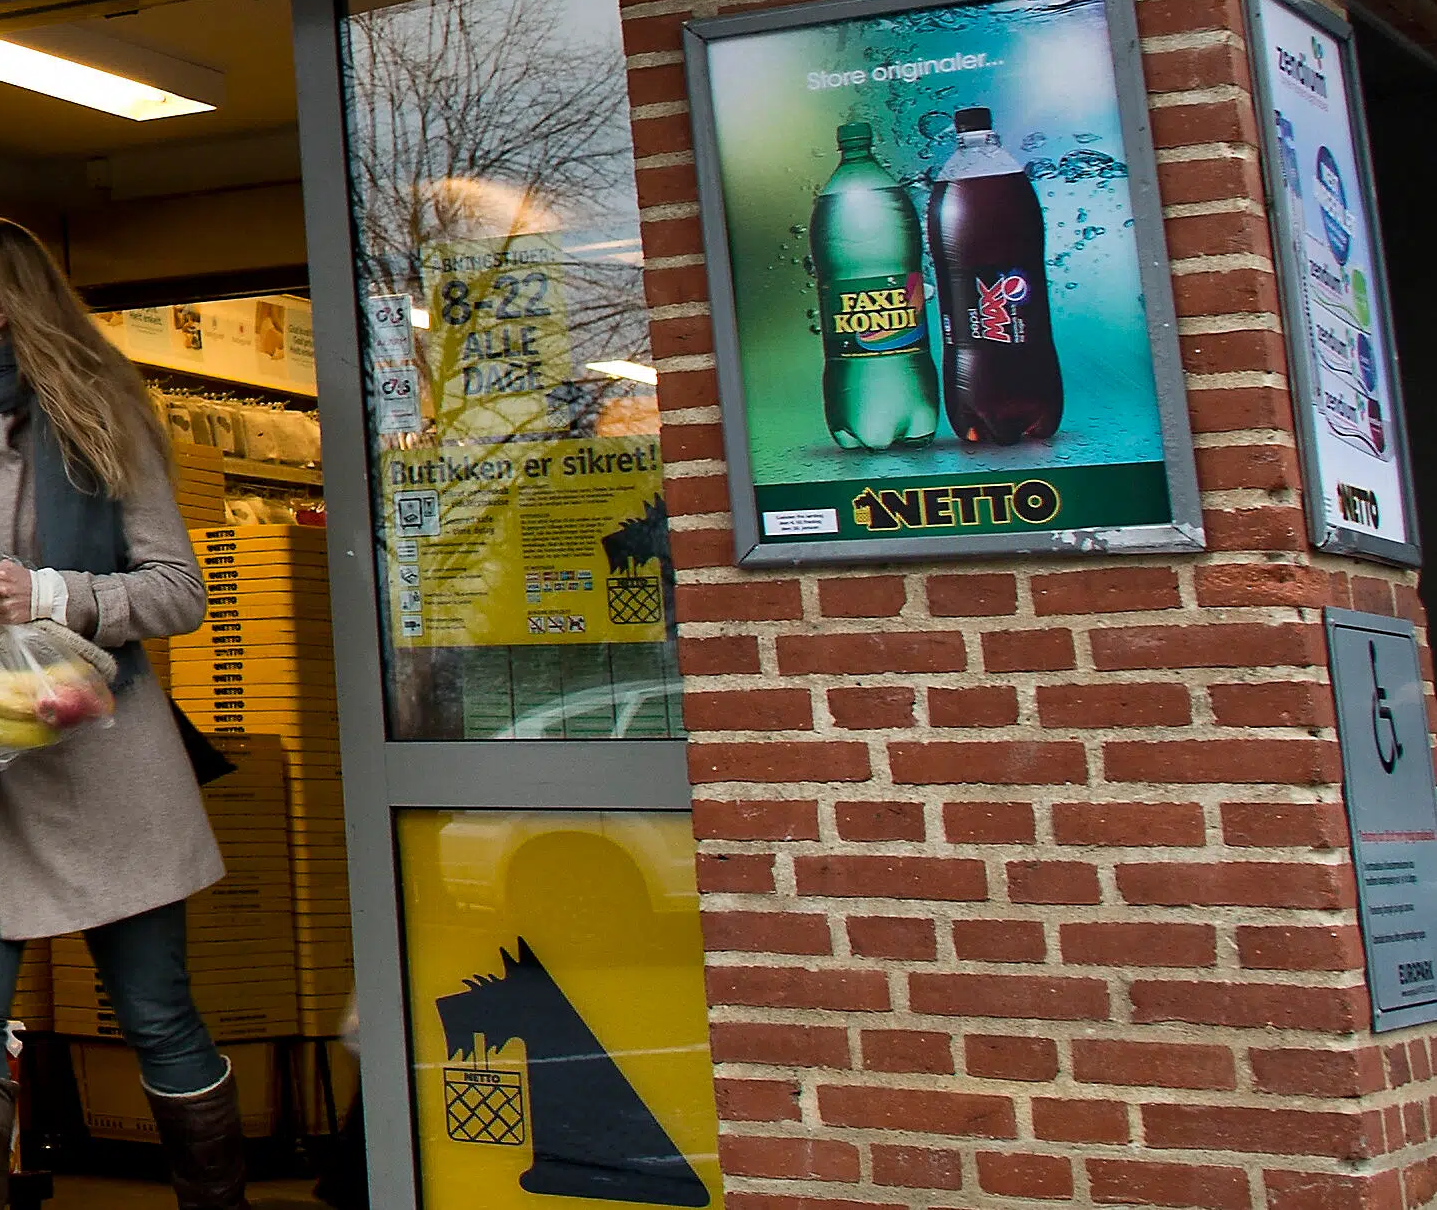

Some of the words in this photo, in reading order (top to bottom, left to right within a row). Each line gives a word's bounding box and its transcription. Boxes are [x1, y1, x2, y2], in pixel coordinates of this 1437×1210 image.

[806, 69, 866, 90] Store
[871, 52, 1005, 83] originaler...
[442, 273, 551, 325] 8-22
[839, 289, 907, 313] FAXE
[975, 276, 1012, 343] MAX
[833, 308, 917, 334] KONDI
[463, 326, 539, 361] ALLE
[463, 361, 545, 395] DAGE
[391, 455, 514, 485] Butikken
[524, 457, 552, 478] er
[562, 444, 658, 475] sikret!
[877, 479, 1061, 529] NETTO
[1340, 485, 1379, 529] NETTO
[463, 1072, 501, 1084] NETTO
